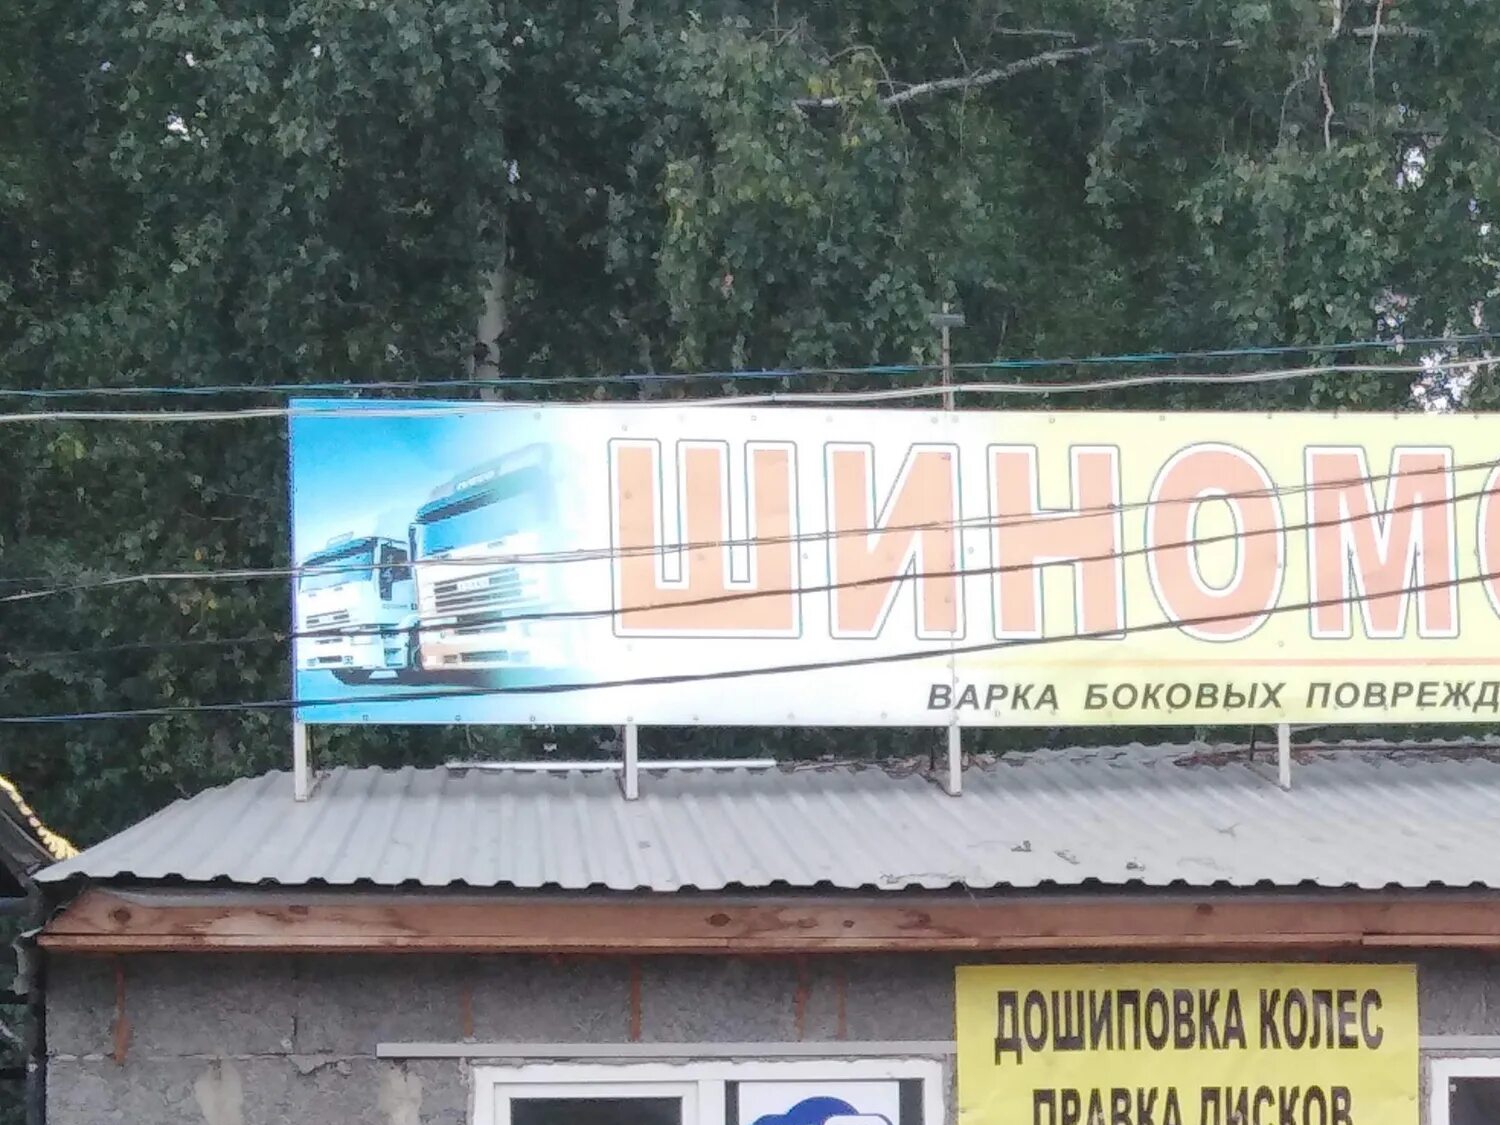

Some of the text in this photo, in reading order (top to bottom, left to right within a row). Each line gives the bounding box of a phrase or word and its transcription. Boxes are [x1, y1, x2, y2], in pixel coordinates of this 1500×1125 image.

[927, 683, 1060, 711] ВАРКА
[1084, 682, 1286, 710] БОКОВЫХ
[994, 988, 1384, 1065] ДОШИПОВКА КОЛЕС
